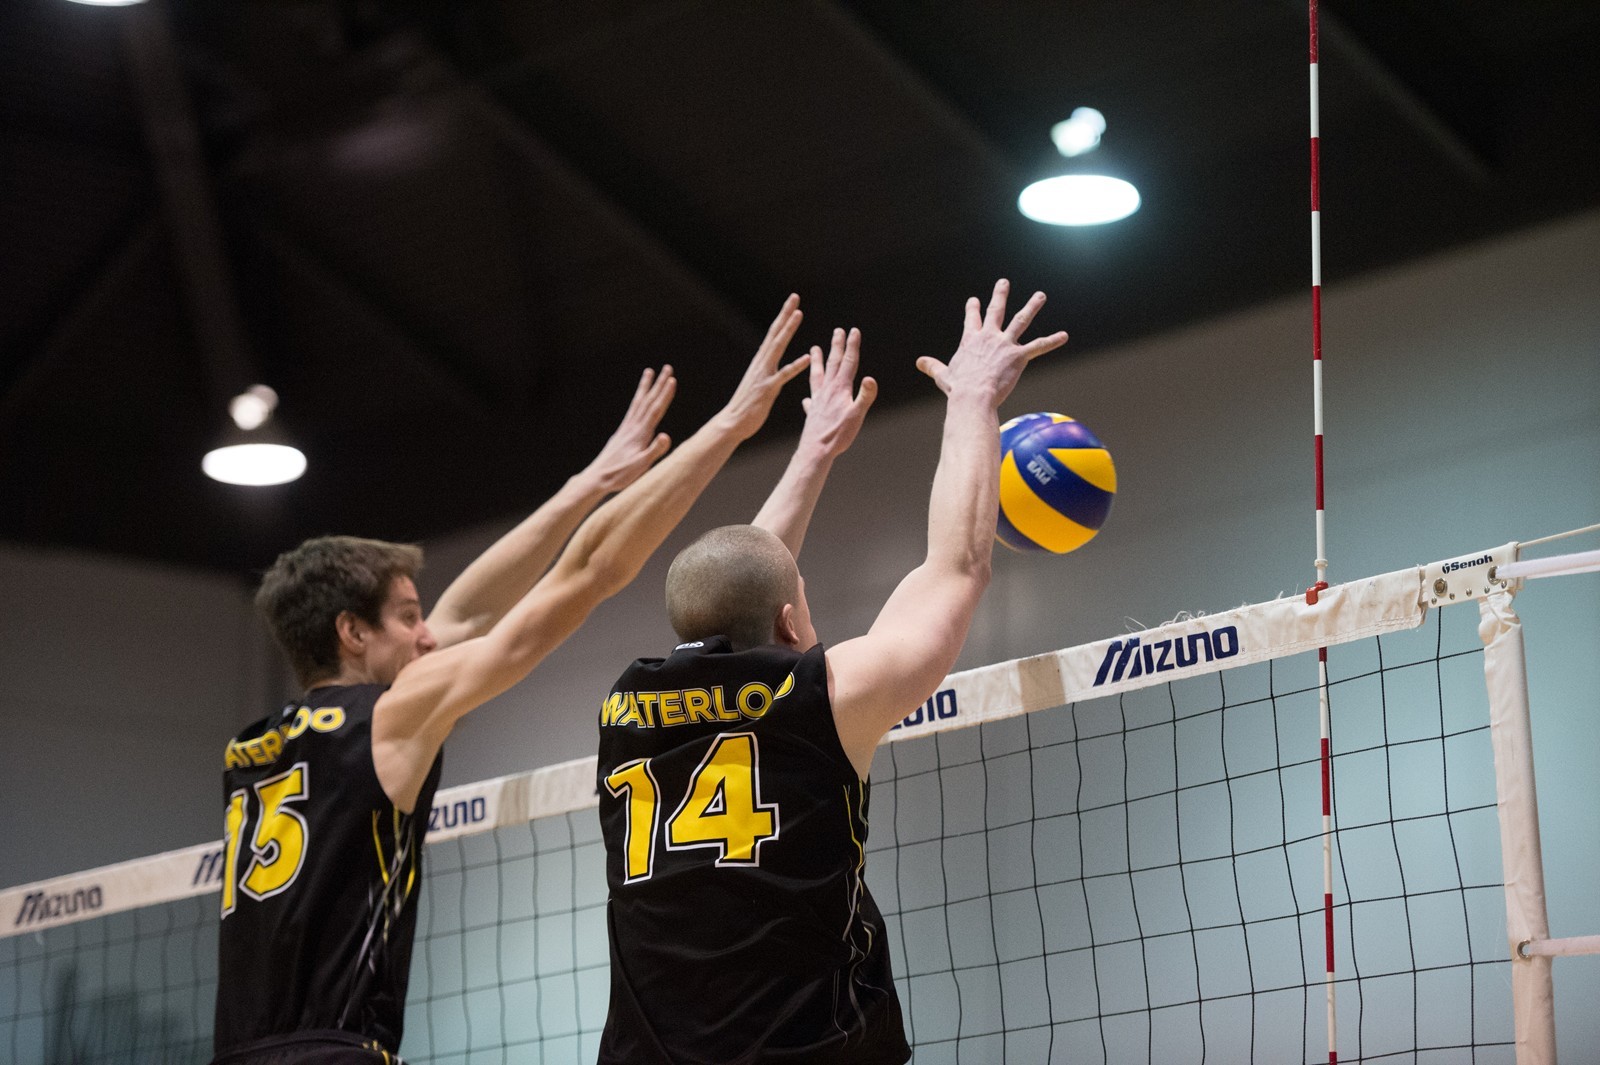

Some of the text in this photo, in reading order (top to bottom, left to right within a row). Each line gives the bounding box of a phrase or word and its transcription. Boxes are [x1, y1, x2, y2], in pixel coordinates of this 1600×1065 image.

[1450, 554, 1494, 572] Senoh
[220, 761, 310, 920] 15
[603, 731, 780, 885] 14
